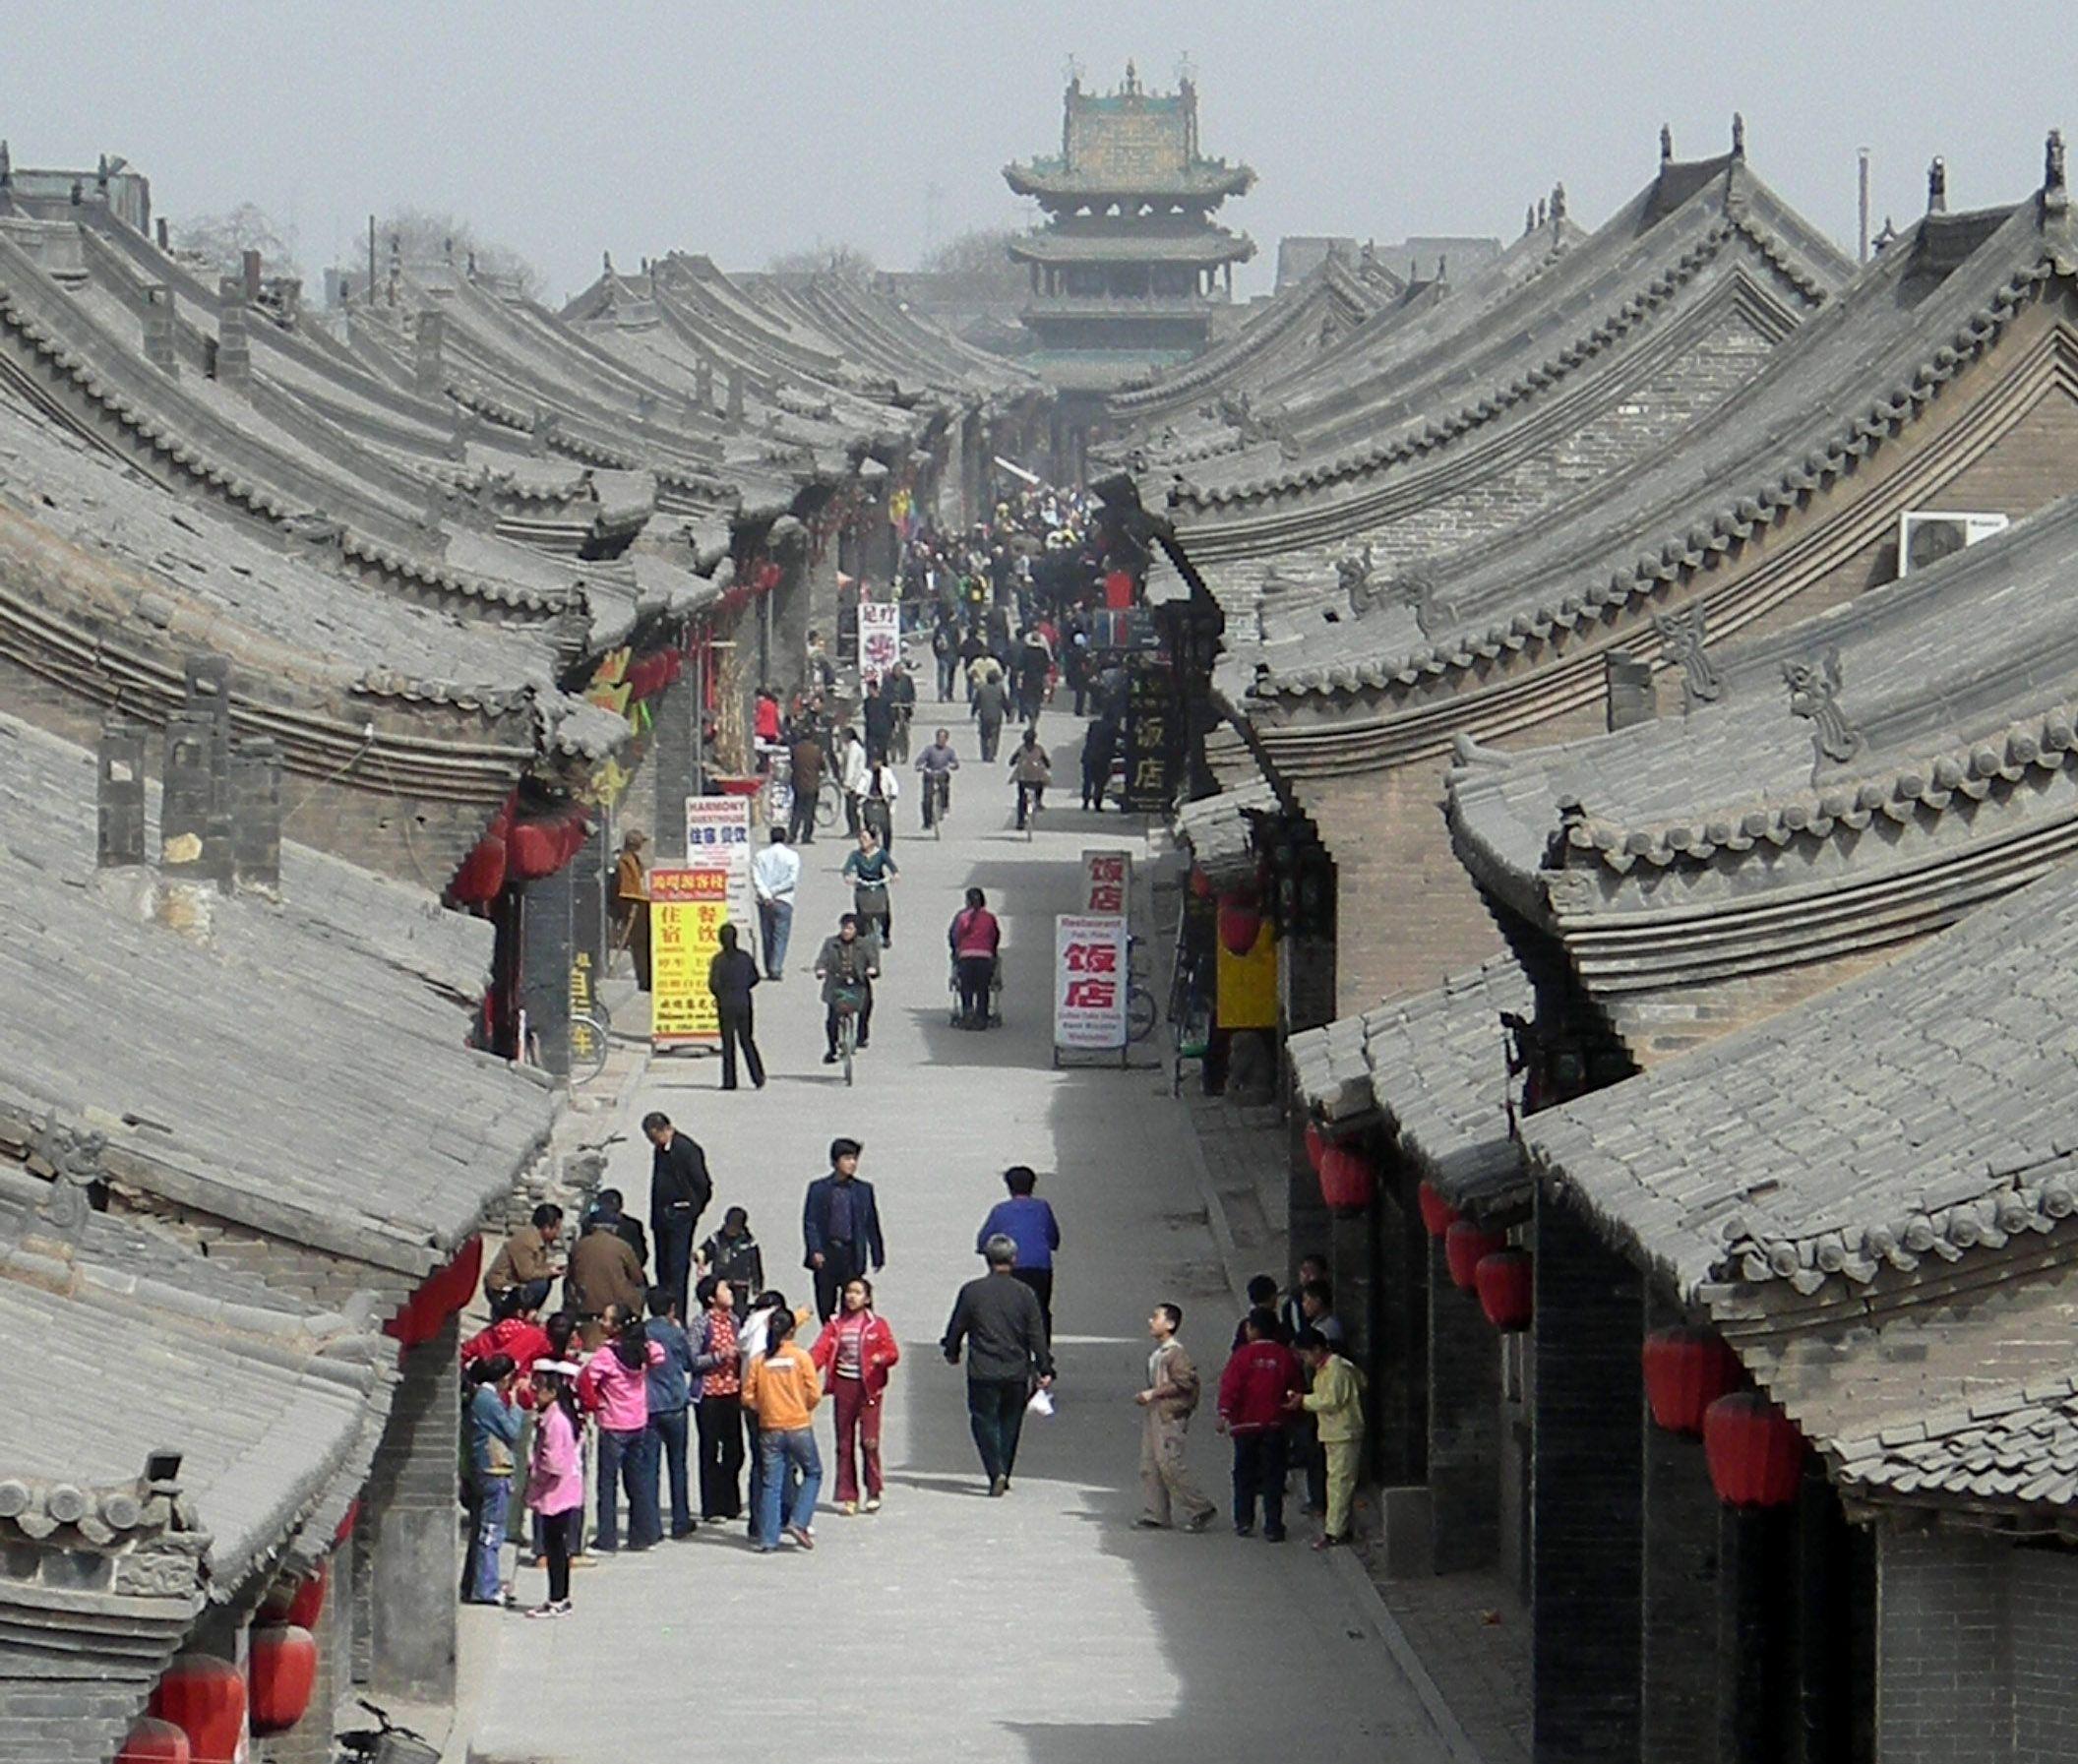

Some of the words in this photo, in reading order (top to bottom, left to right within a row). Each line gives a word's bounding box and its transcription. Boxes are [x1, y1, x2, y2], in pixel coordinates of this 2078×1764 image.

[689, 801, 745, 812] HARMONY
[1089, 857, 1124, 911] 饭店
[1064, 943, 1117, 1008] 饭店
